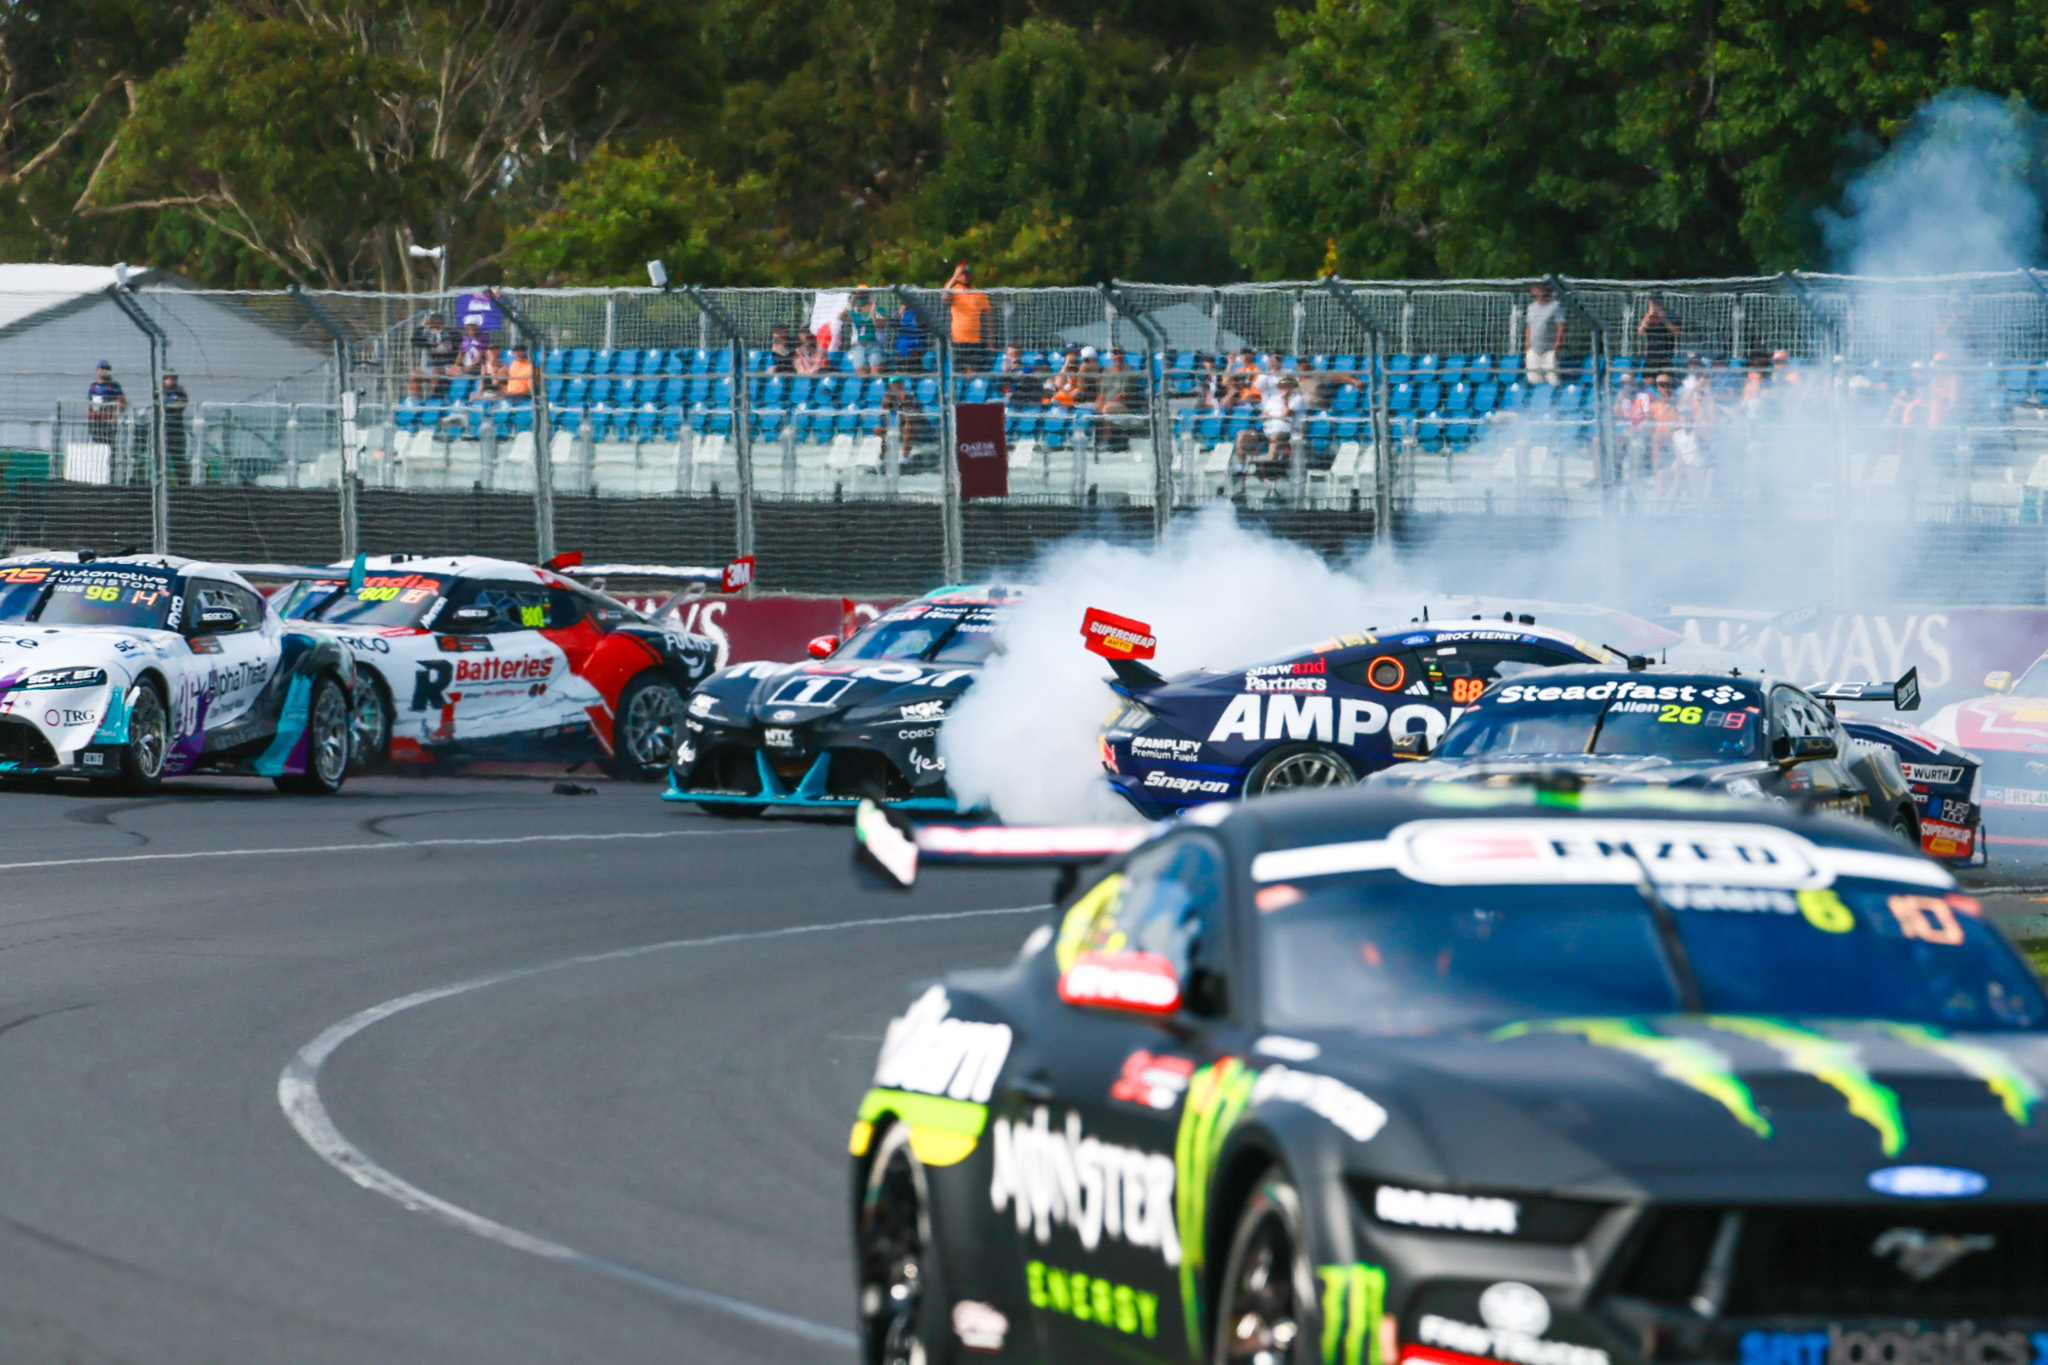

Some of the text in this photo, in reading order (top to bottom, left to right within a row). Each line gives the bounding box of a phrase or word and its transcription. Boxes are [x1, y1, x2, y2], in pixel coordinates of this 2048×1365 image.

[51, 569, 169, 584] Automotive
[727, 563, 750, 587] 3M
[45, 576, 169, 591] SUPERSTORE
[84, 585, 120, 601] 96
[358, 586, 400, 601] 800
[1089, 621, 1156, 648] SUPERCHEAP
[1435, 631, 1521, 643] BROC FEENEY
[1107, 637, 1131, 650] AUTO
[455, 655, 555, 682] Batteries
[1245, 676, 1328, 691] Partners
[1452, 678, 1484, 703] 88
[1496, 681, 1698, 704] Steadfast
[63, 709, 95, 722] TRG
[1609, 701, 1704, 725] Allen 26
[1143, 739, 1202, 753] AMPLIFY
[1131, 746, 1199, 762] Premium Fuels
[1143, 770, 1230, 794] Snap-on
[1940, 811, 1967, 825] LOCK
